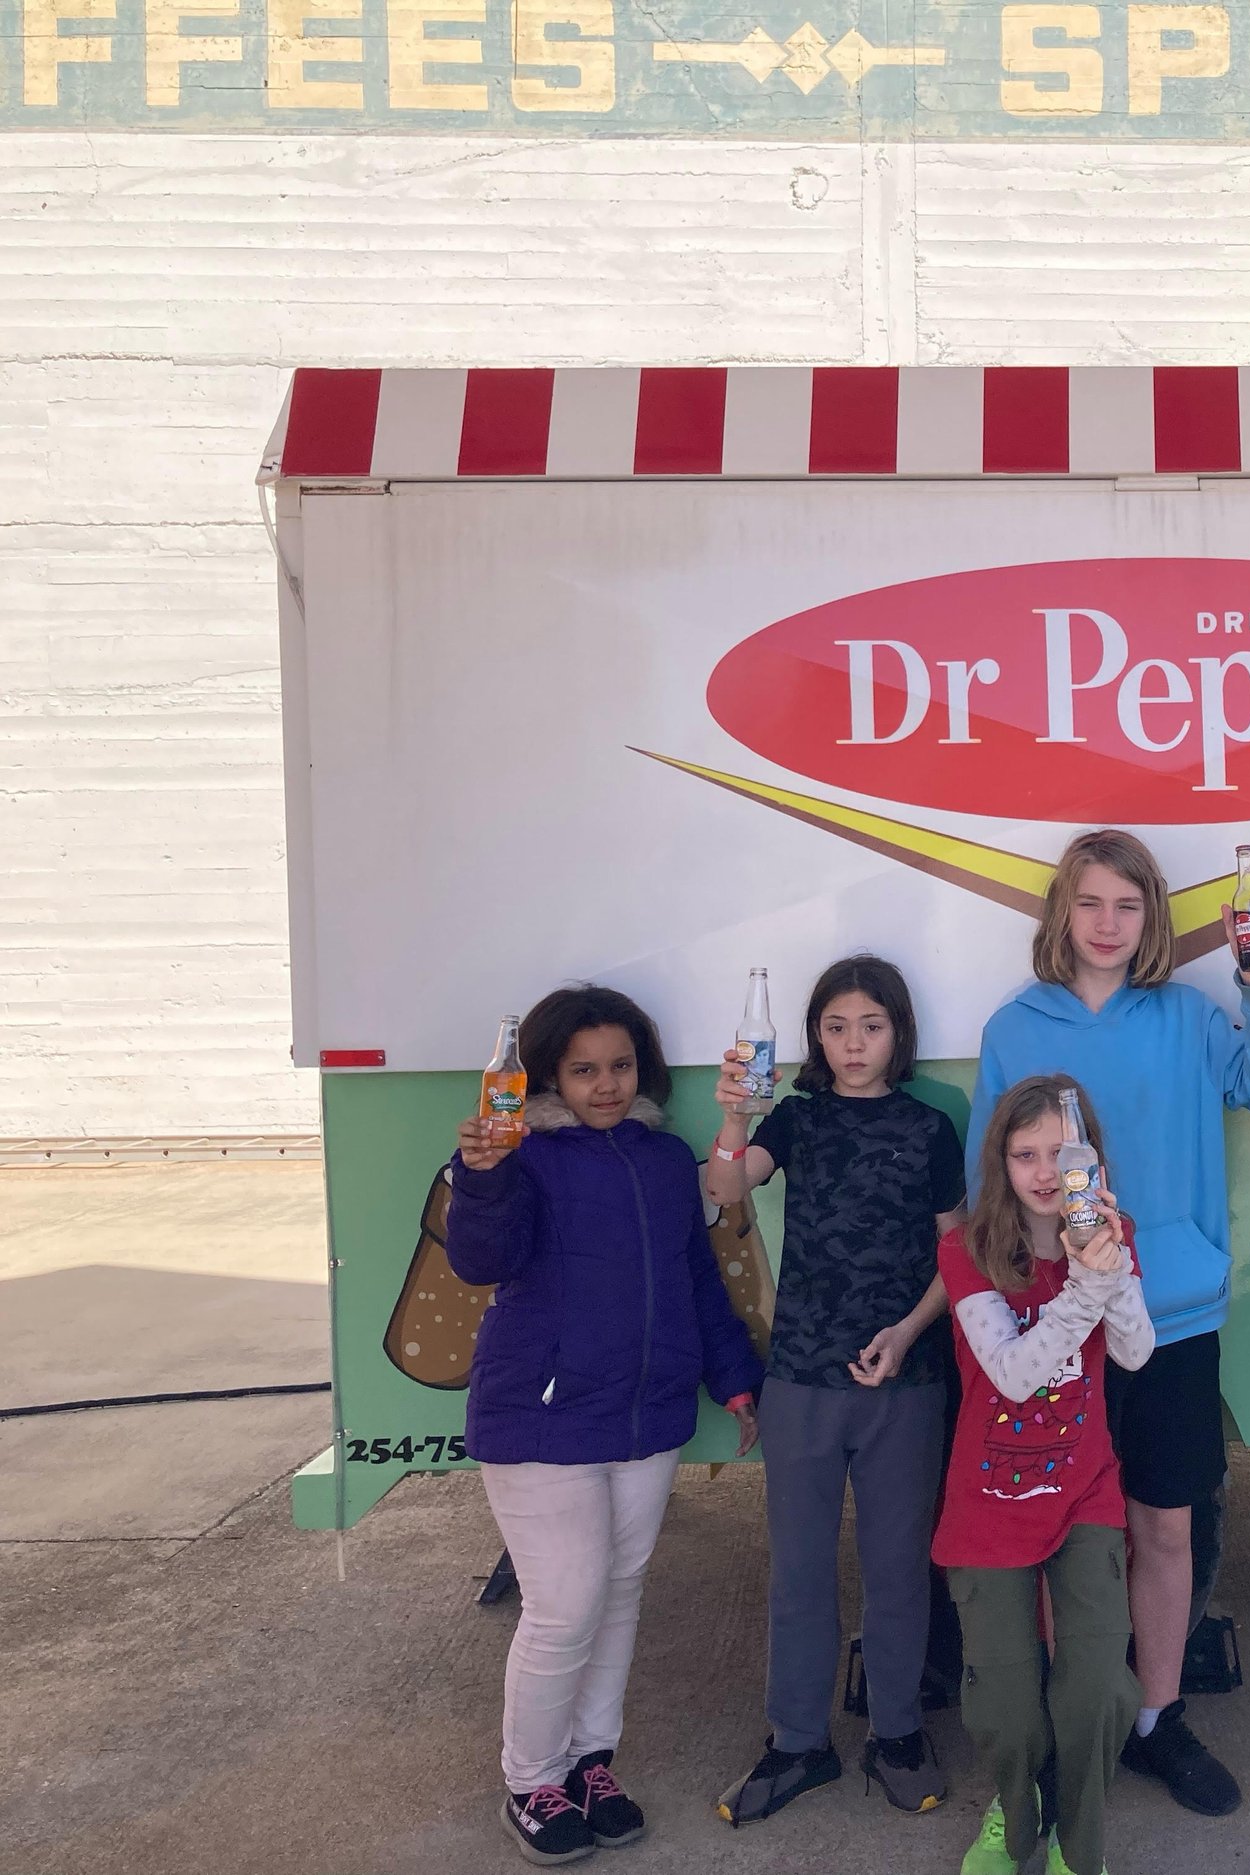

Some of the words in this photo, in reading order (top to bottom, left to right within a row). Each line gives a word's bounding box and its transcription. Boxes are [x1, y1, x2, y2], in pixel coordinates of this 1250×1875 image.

[23, 0, 617, 113] FFEES
[834, 640, 999, 745] Dr
[346, 1436, 468, 1464] 254-75
